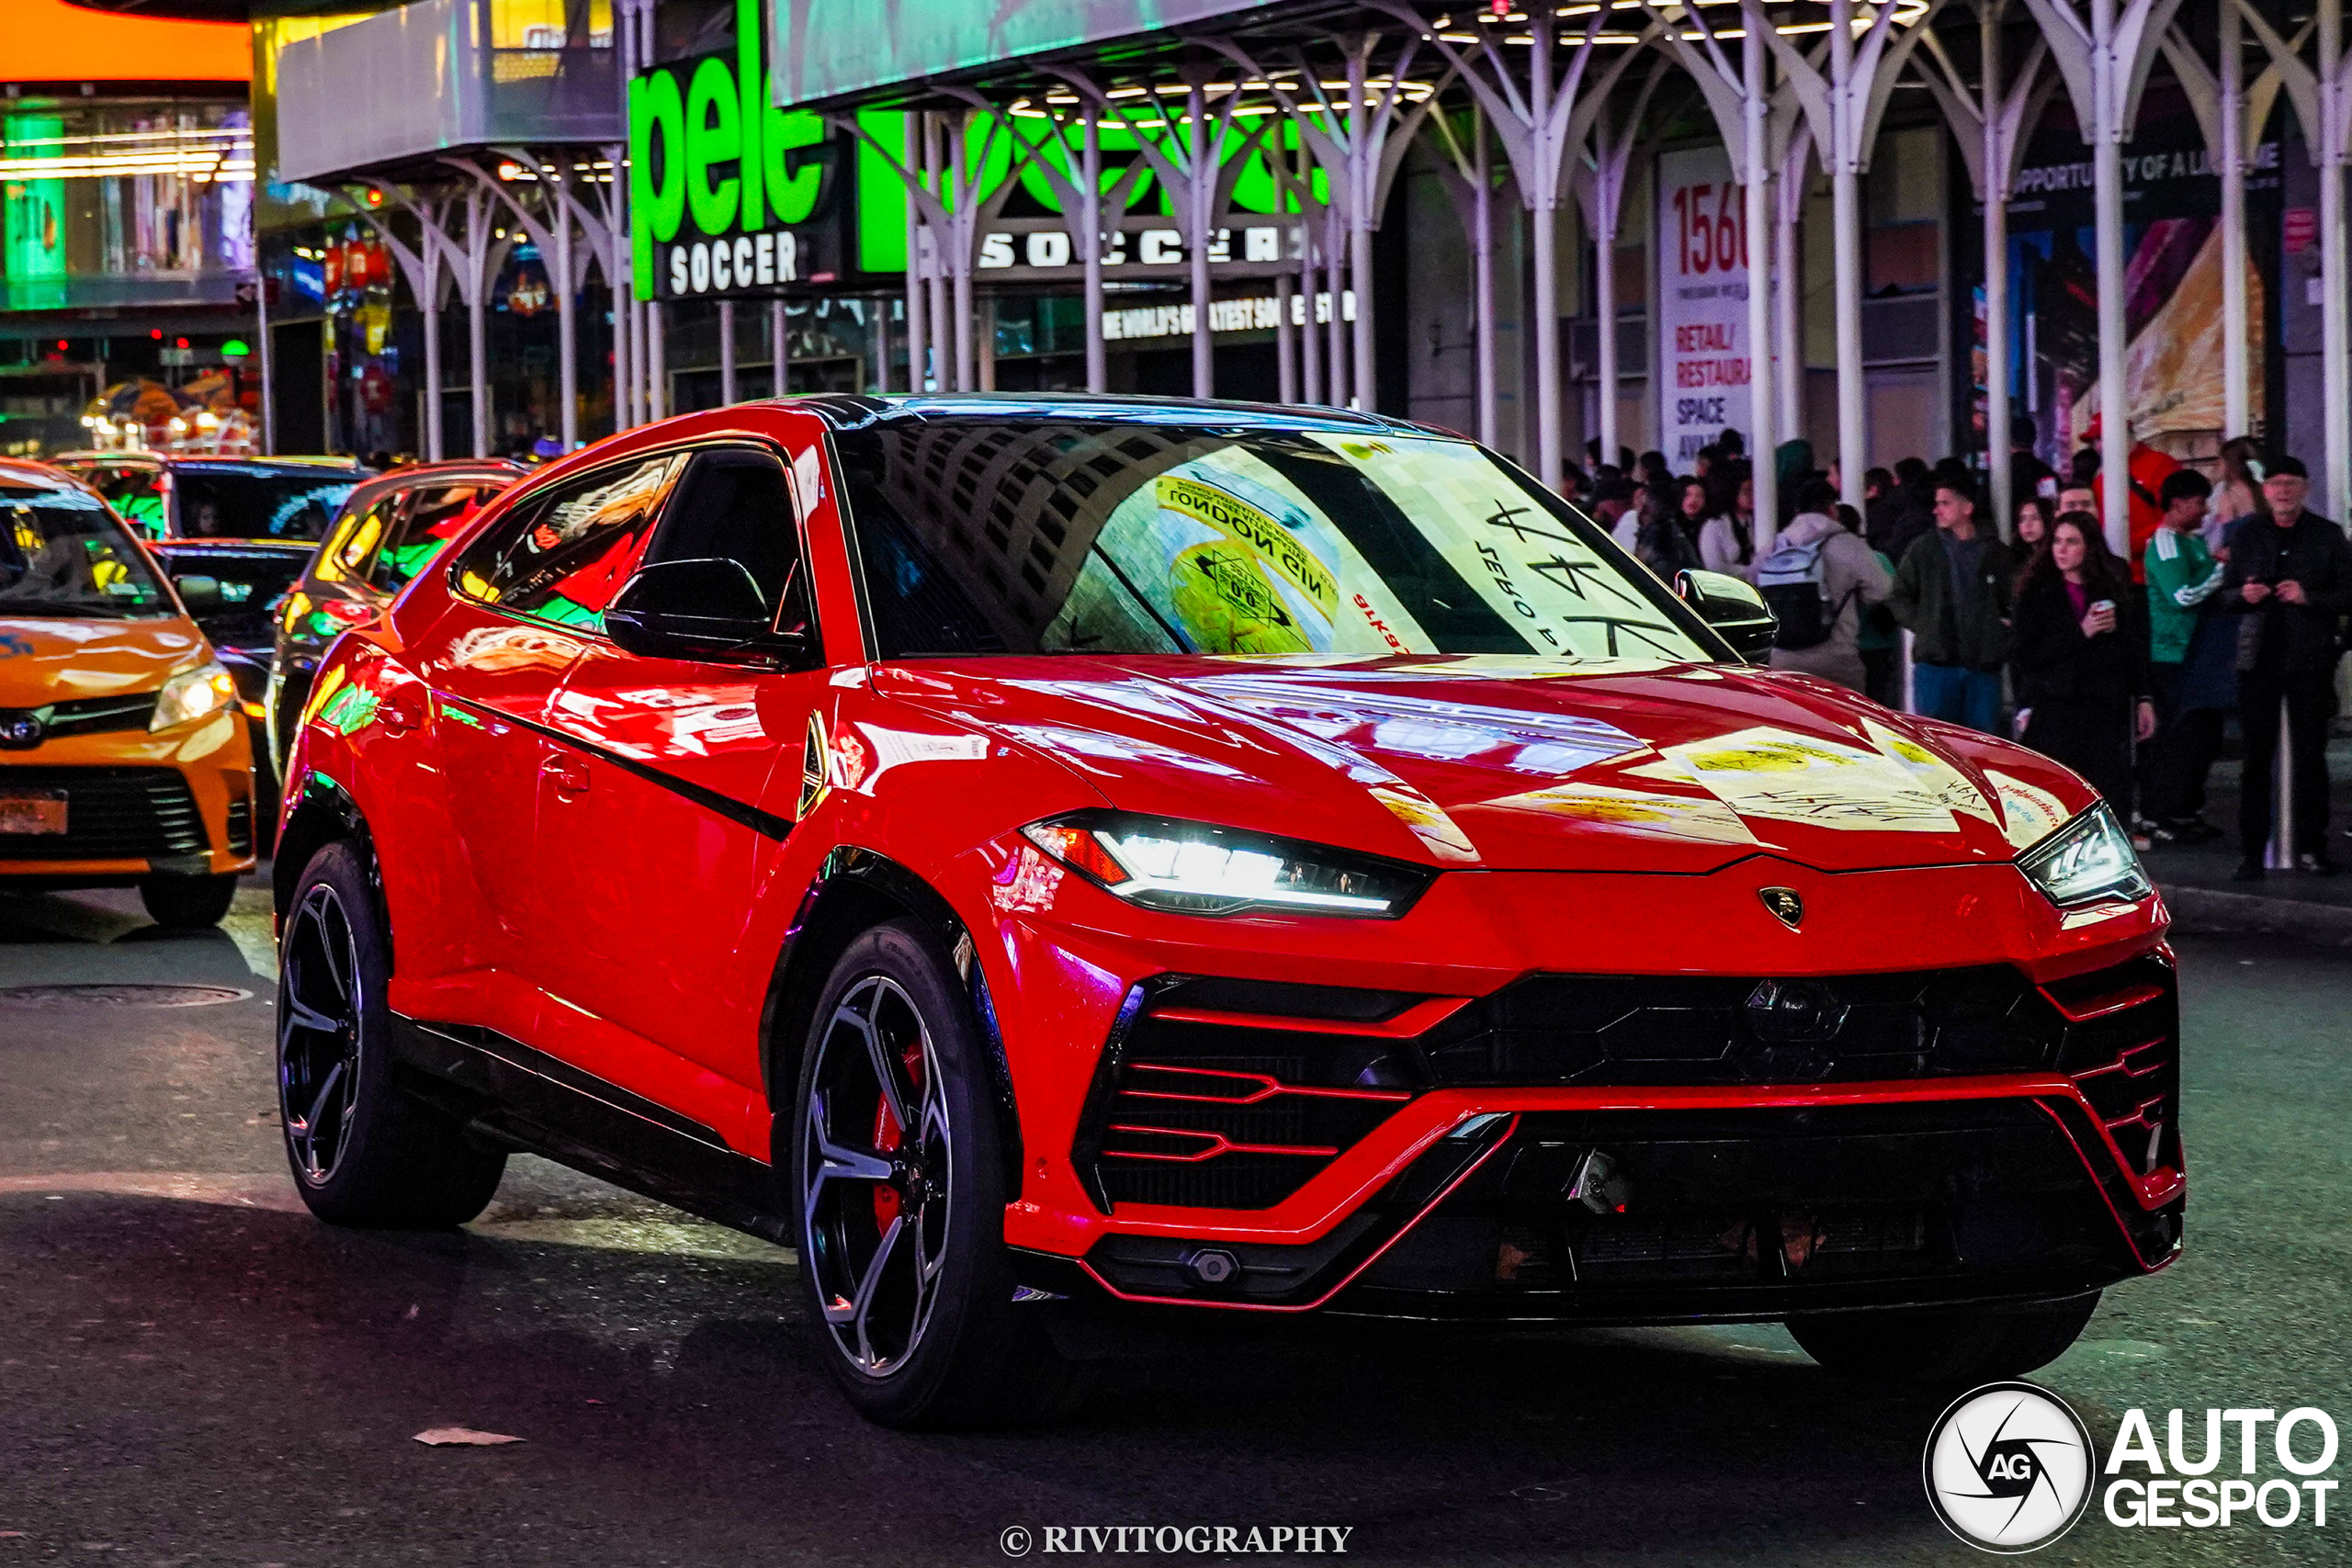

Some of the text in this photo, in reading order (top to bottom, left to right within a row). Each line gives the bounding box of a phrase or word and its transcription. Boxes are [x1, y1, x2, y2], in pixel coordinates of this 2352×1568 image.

[2142, 153, 2169, 181] OF
[2170, 152, 2186, 178] A
[670, 231, 797, 295] SOCCER
[1677, 397, 1726, 425] SPACE
